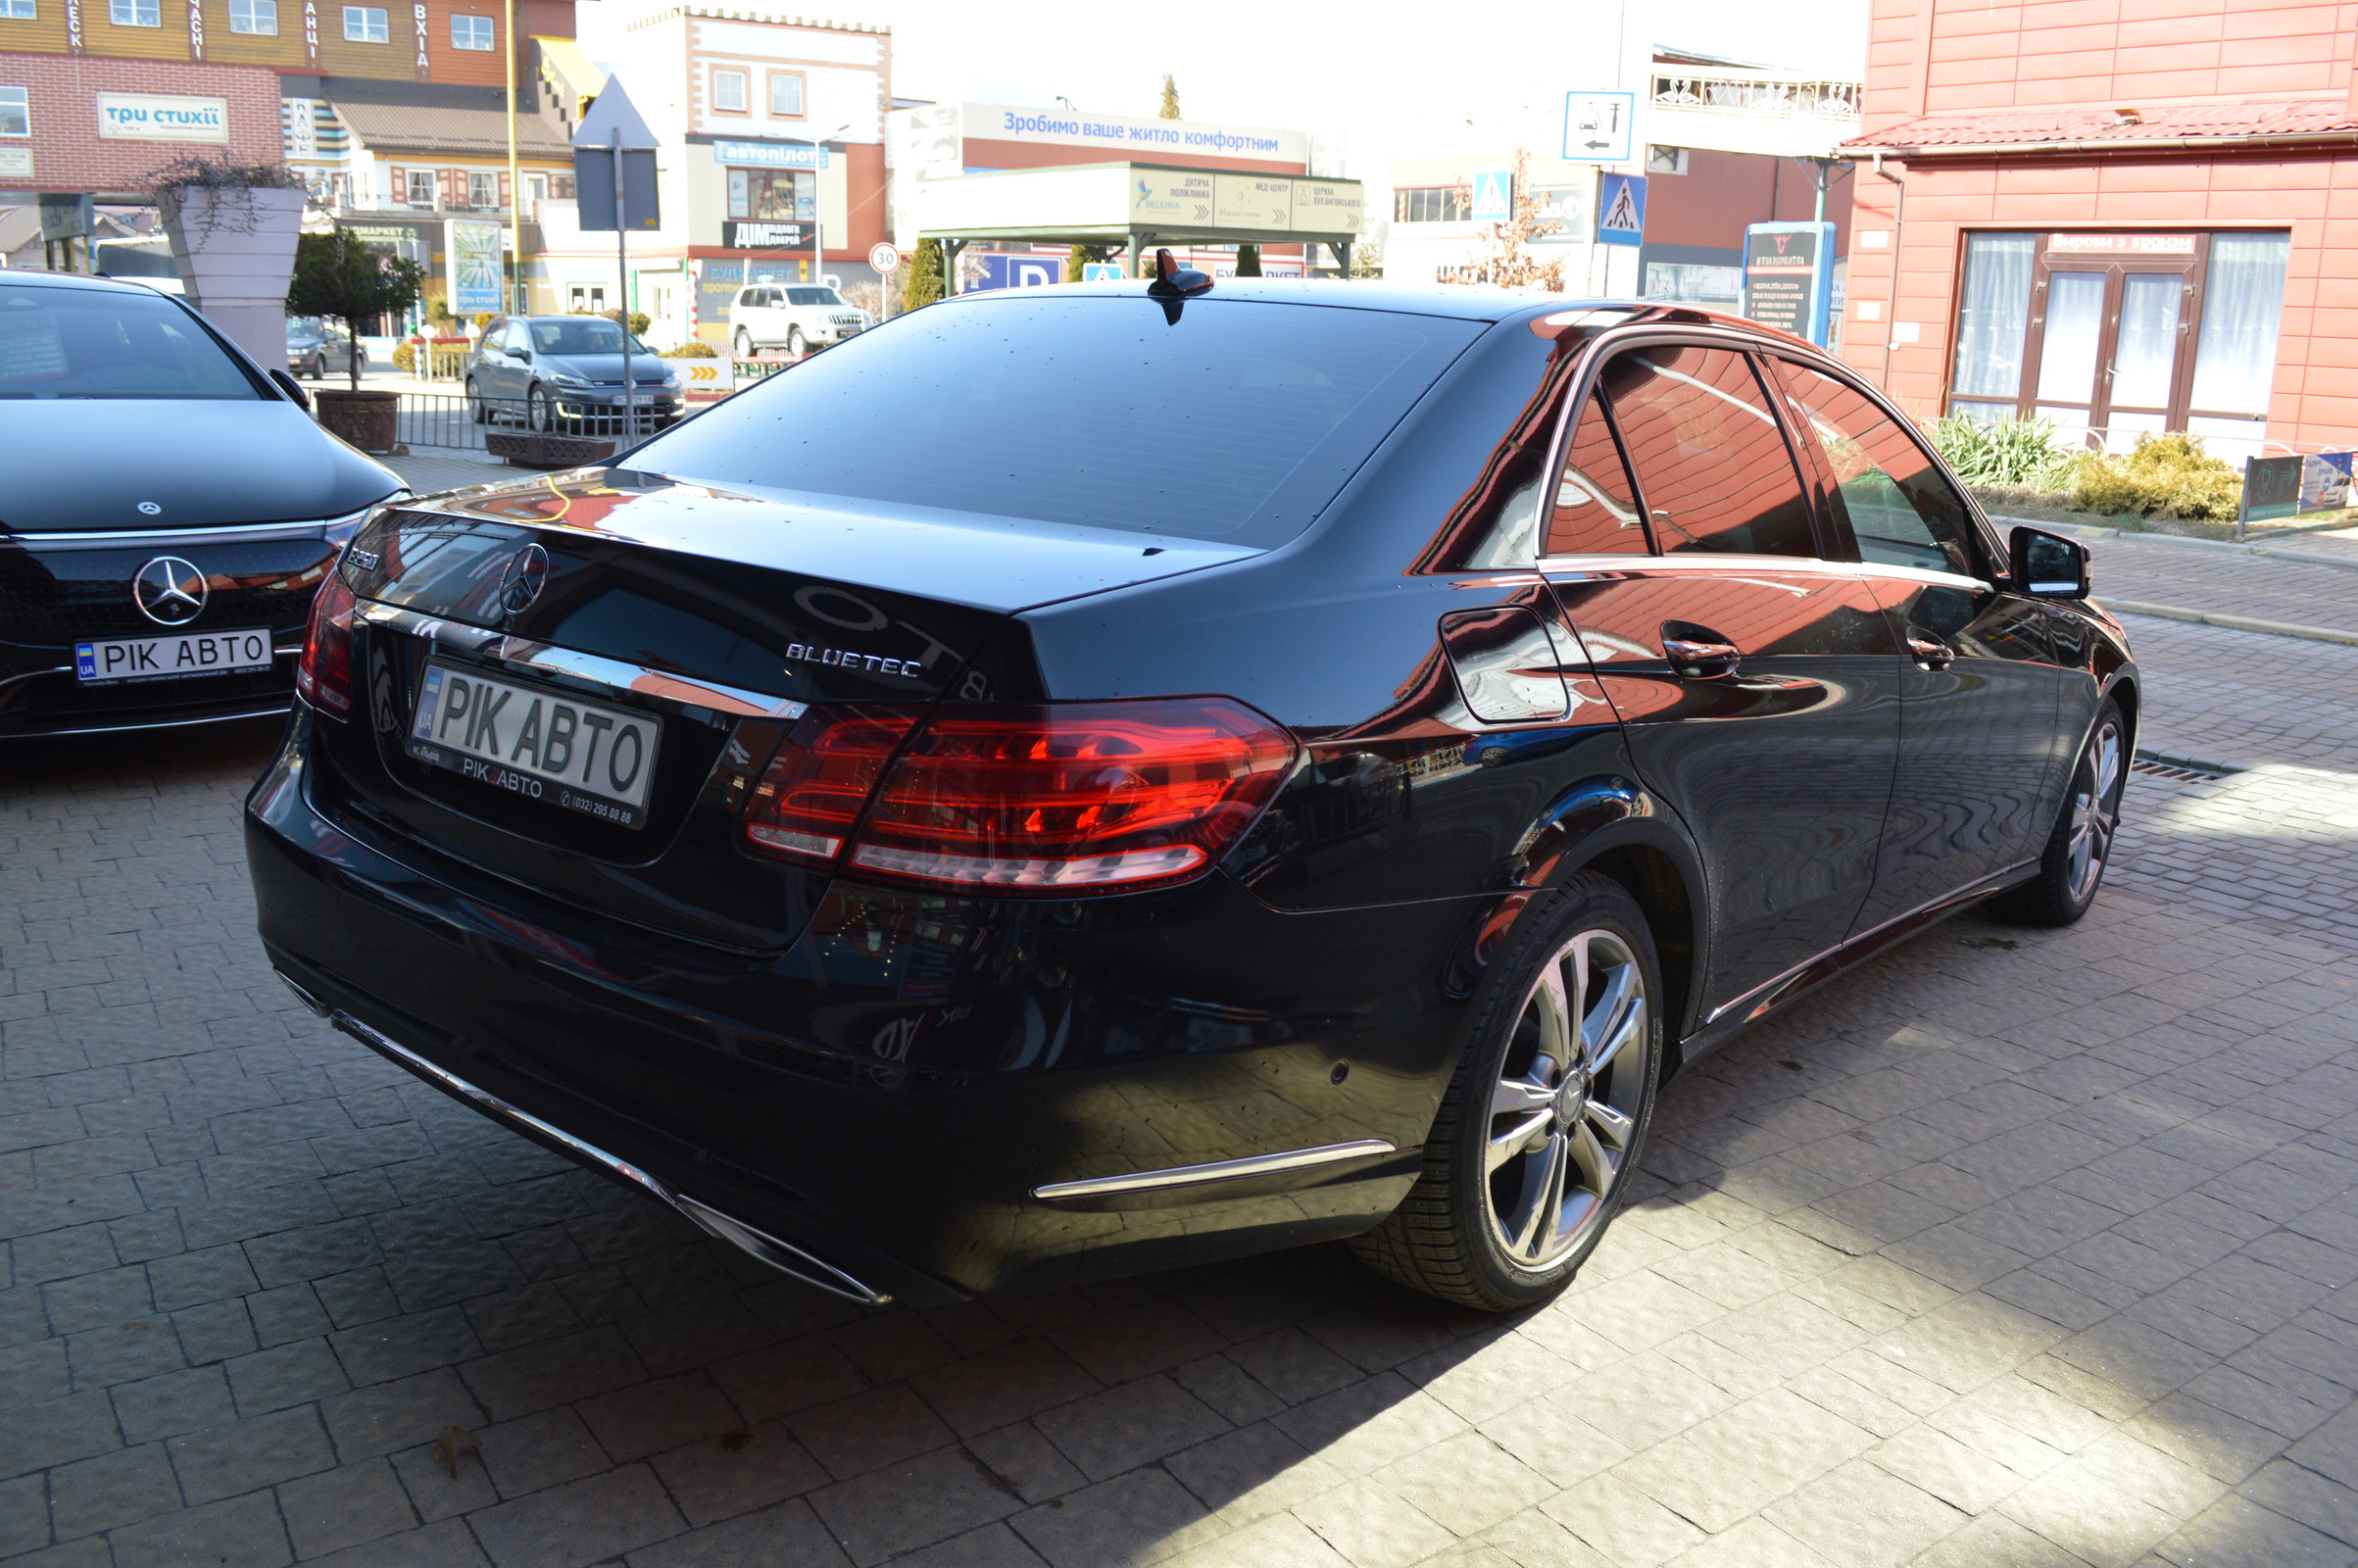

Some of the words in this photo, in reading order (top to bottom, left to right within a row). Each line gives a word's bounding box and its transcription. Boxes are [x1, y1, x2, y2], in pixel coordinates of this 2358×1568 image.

[106, 108, 148, 123] три
[154, 108, 220, 124] стихії
[1004, 112, 1079, 134] Зробимо
[1082, 122, 1125, 139] ваше
[1128, 126, 1180, 144] житло
[1184, 130, 1279, 152] комфортним
[726, 145, 816, 164] автопілот
[1184, 177, 1209, 188] ДИТЯЧА
[1255, 181, 1289, 193] МЕД-ЦЕНТР
[1313, 185, 1334, 196] ЦЕРКВА
[1169, 187, 1210, 199] ПОЛІКЛІНІКА
[1146, 200, 1180, 210] ВЕСЕЛКА
[734, 222, 769, 248] ДІМ
[2052, 233, 2113, 252] Вироби
[2117, 236, 2127, 248] з
[877, 253, 894, 265] 30
[716, 306, 731, 317] ва
[785, 643, 922, 678] BLUETEC
[80, 665, 95, 675] UA
[418, 711, 432, 731] UA
[412, 747, 420, 757] м.
[420, 746, 440, 762] Львів
[572, 795, 593, 812] (032)
[593, 799, 608, 816] 295
[609, 804, 620, 821] 88
[620, 808, 632, 825] 88
